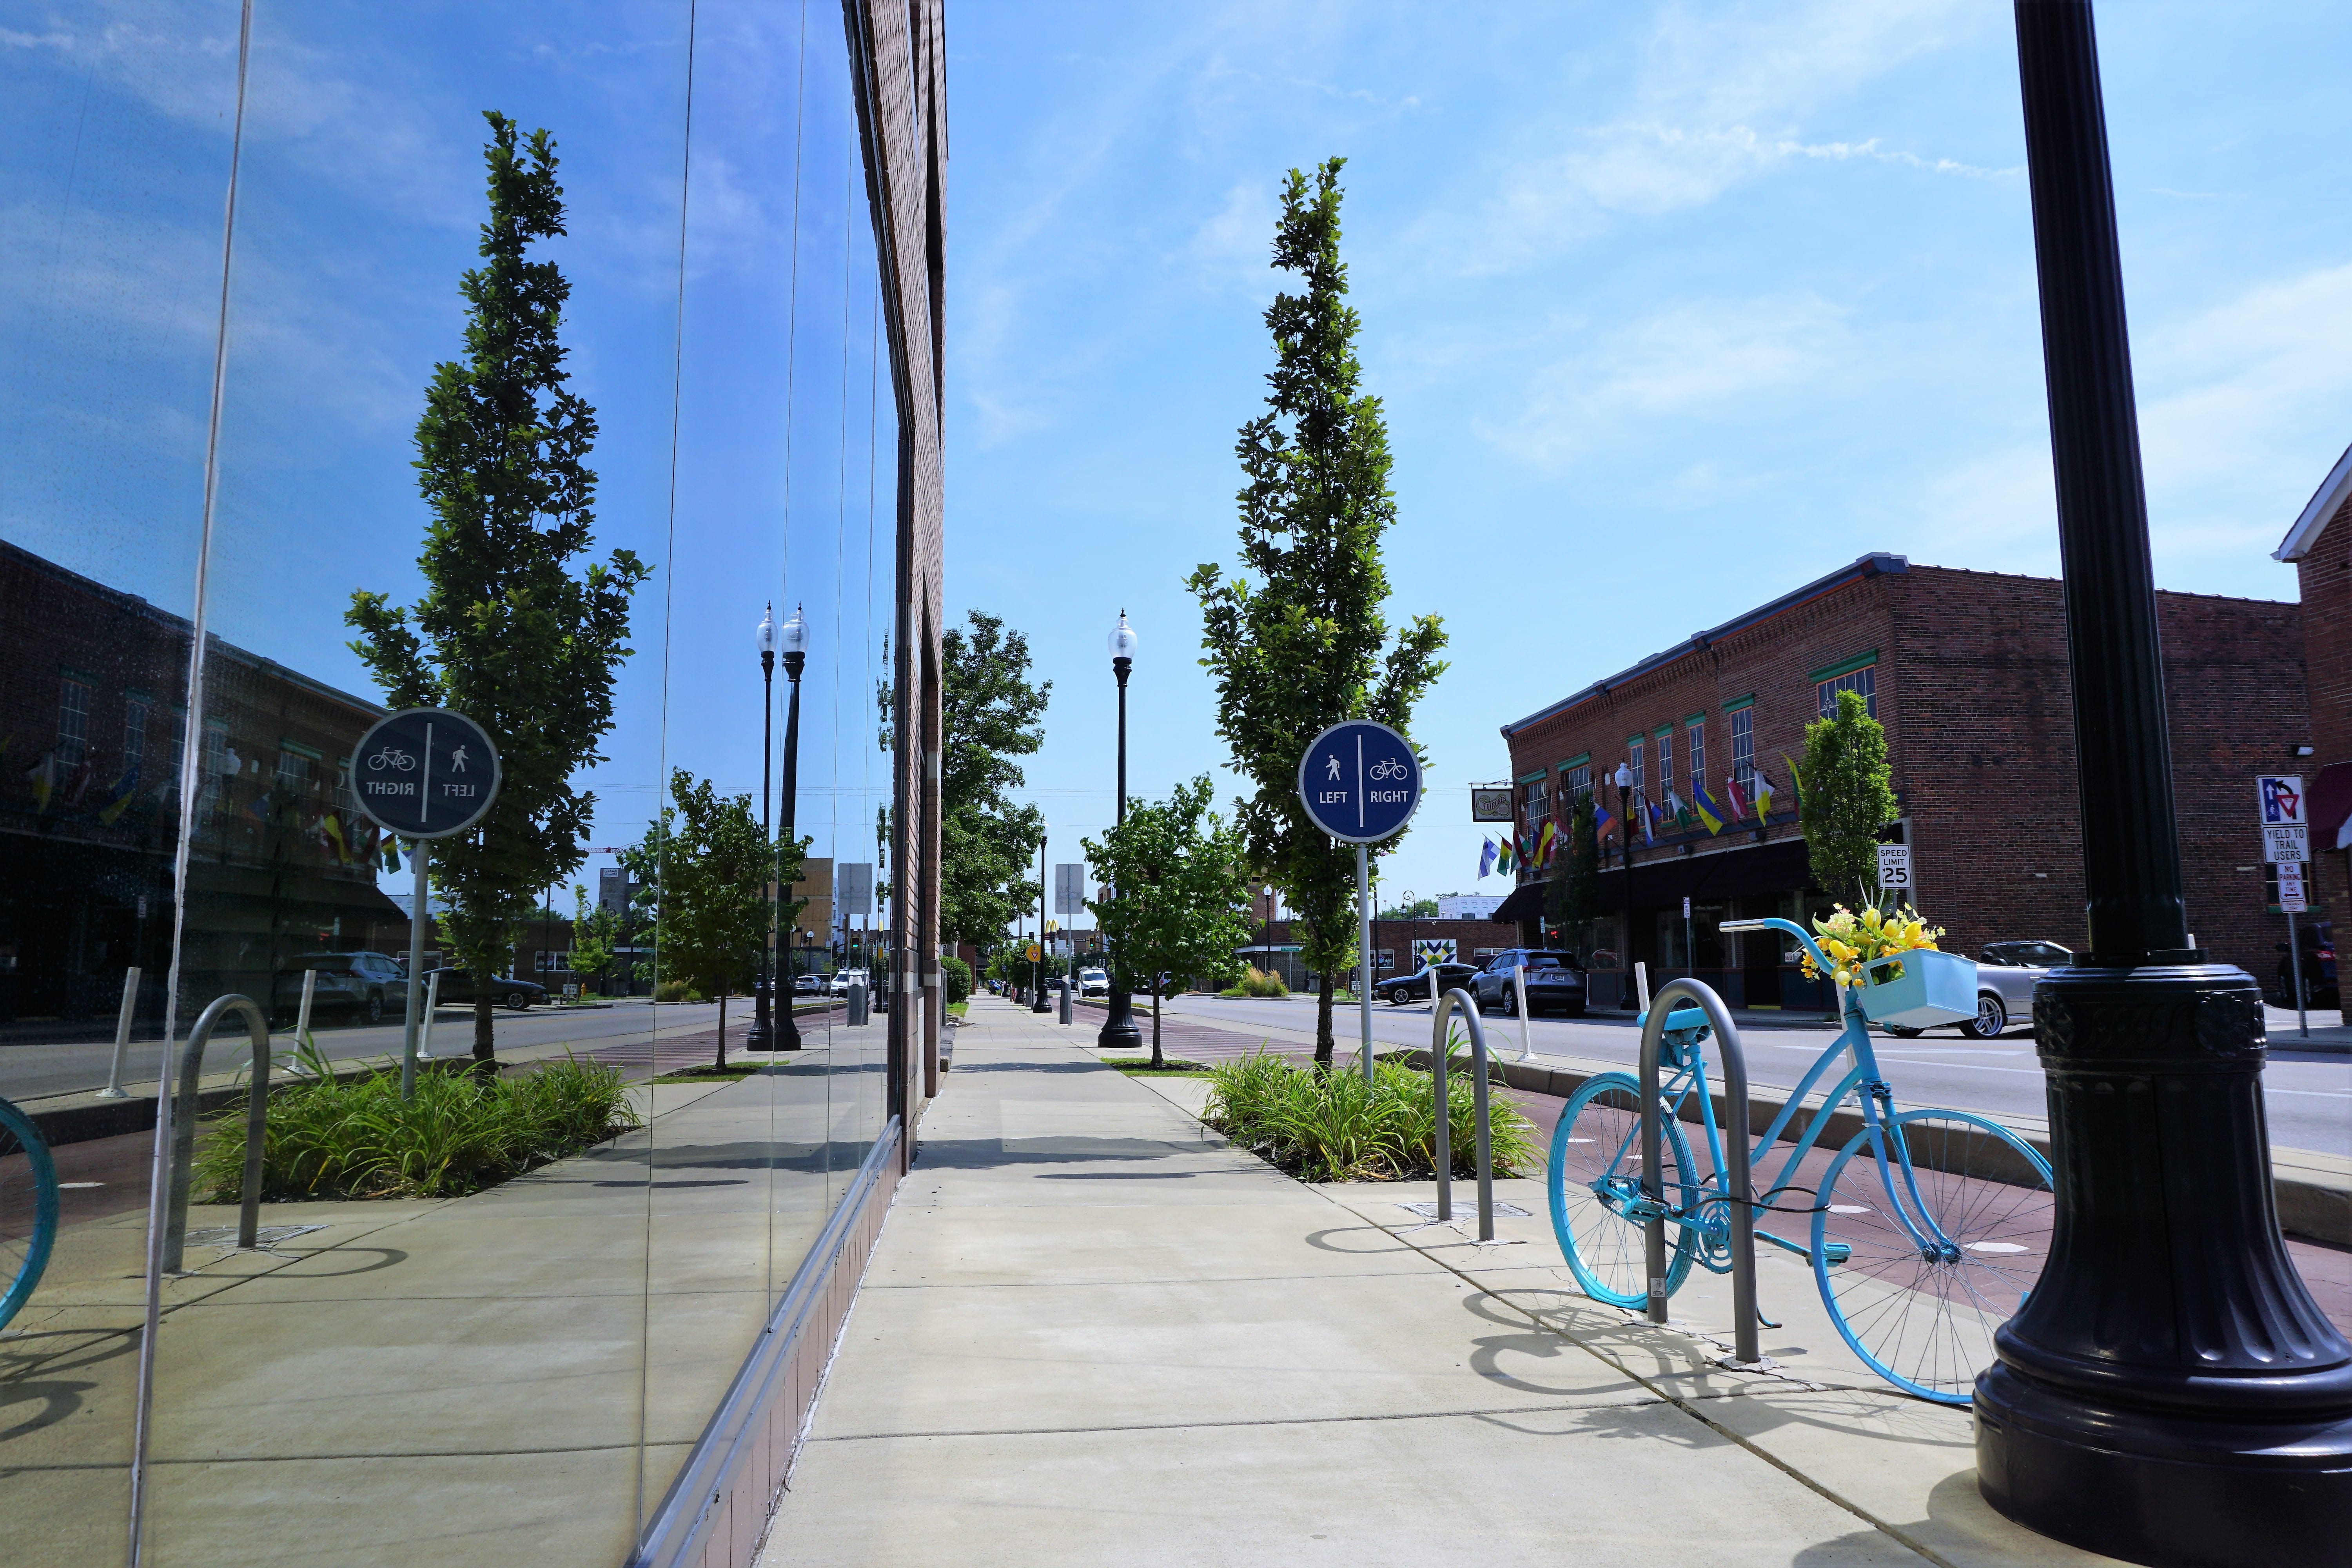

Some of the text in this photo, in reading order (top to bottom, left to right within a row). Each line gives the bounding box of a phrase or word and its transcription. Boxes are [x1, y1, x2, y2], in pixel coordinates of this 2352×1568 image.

[1319, 792, 1347, 803] LEFT
[1370, 791, 1408, 802] RIGHT
[2267, 829, 2303, 839] YIELD TO
[2275, 840, 2298, 849] TRAIL
[2274, 851, 2301, 860] USERS
[1882, 867, 1907, 883] 25
